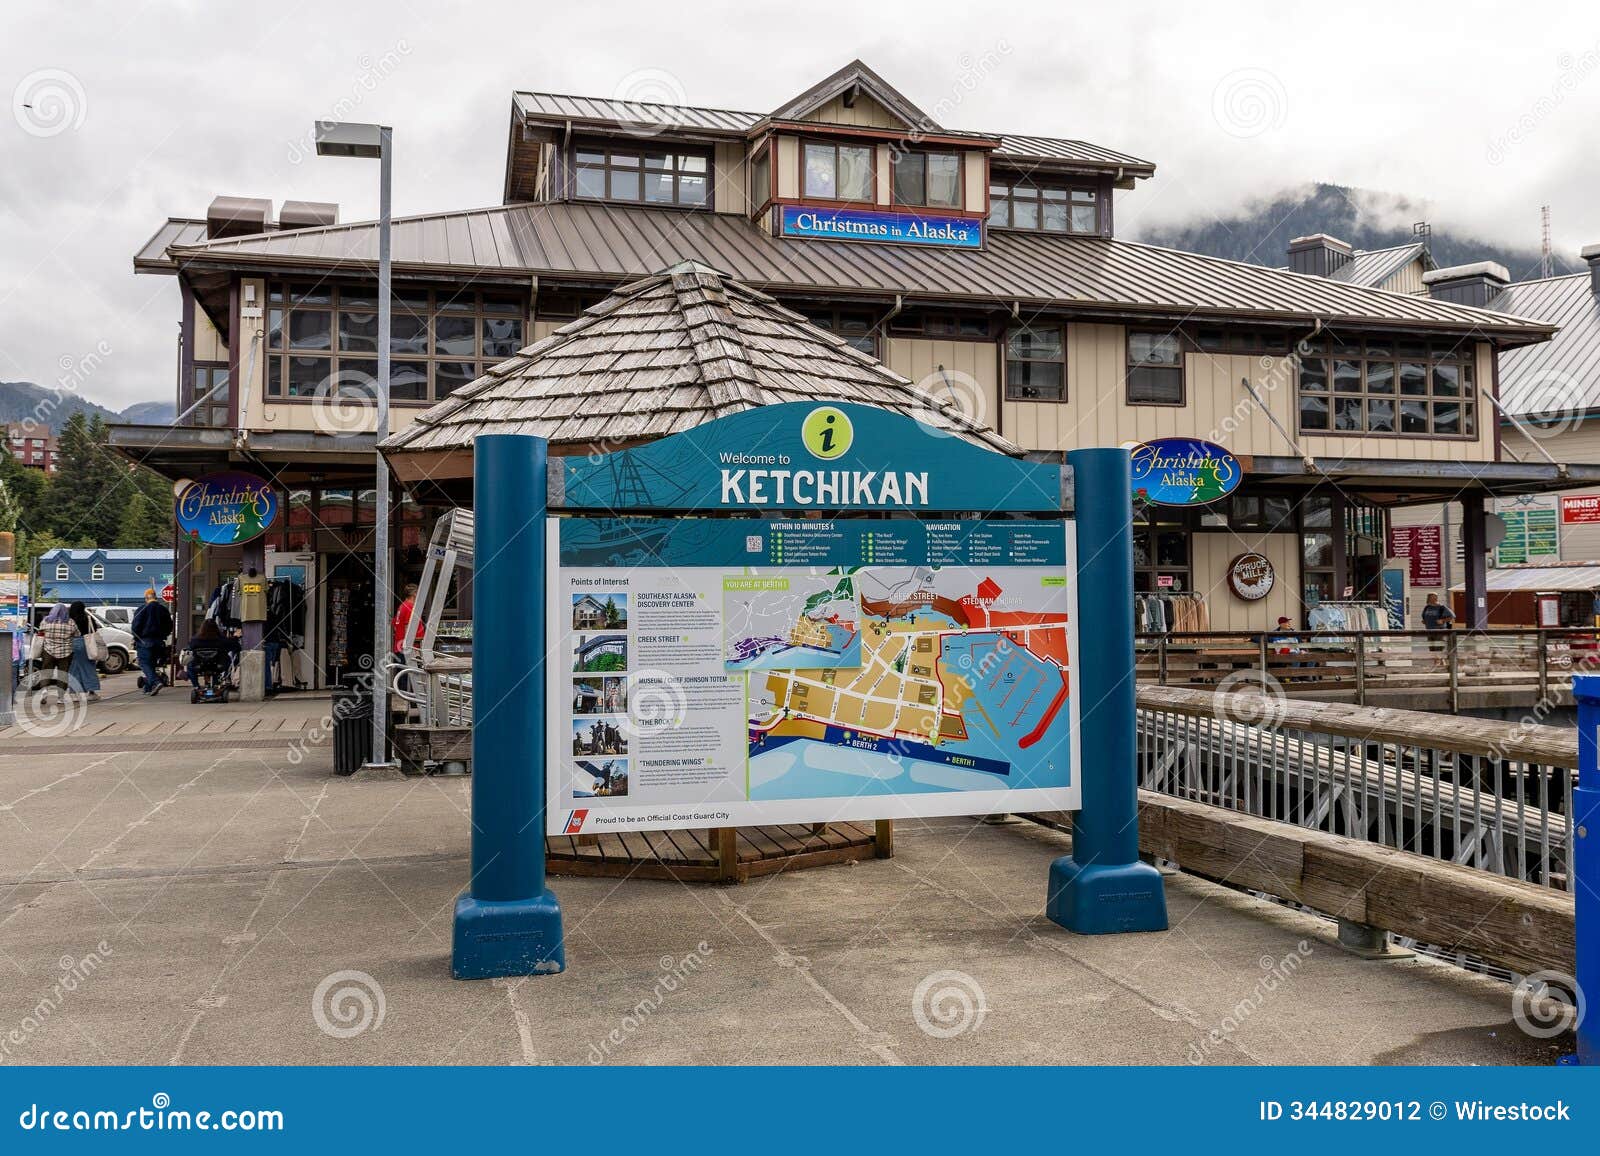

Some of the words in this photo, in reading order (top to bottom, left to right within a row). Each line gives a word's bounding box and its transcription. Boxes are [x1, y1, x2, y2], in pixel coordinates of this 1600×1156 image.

[797, 214, 888, 236] Christmas
[891, 226, 902, 236] in
[907, 222, 968, 241] Alaska
[719, 453, 776, 465] Welcome
[778, 453, 791, 465] to
[1160, 473, 1205, 486] Alaska
[721, 469, 929, 505] KETCHIKAN
[181, 482, 270, 520] Christmas
[1564, 498, 1600, 508] MINER
[208, 510, 245, 525] Alaska
[1235, 560, 1267, 572] SPRUCE
[1242, 568, 1264, 579] MILL
[571, 578, 592, 586] Points
[594, 578, 601, 586] of
[602, 578, 629, 586] Interest
[913, 592, 939, 600] STREET
[852, 740, 872, 750] BERTH
[952, 756, 971, 766] BERTH
[716, 812, 729, 820] City
